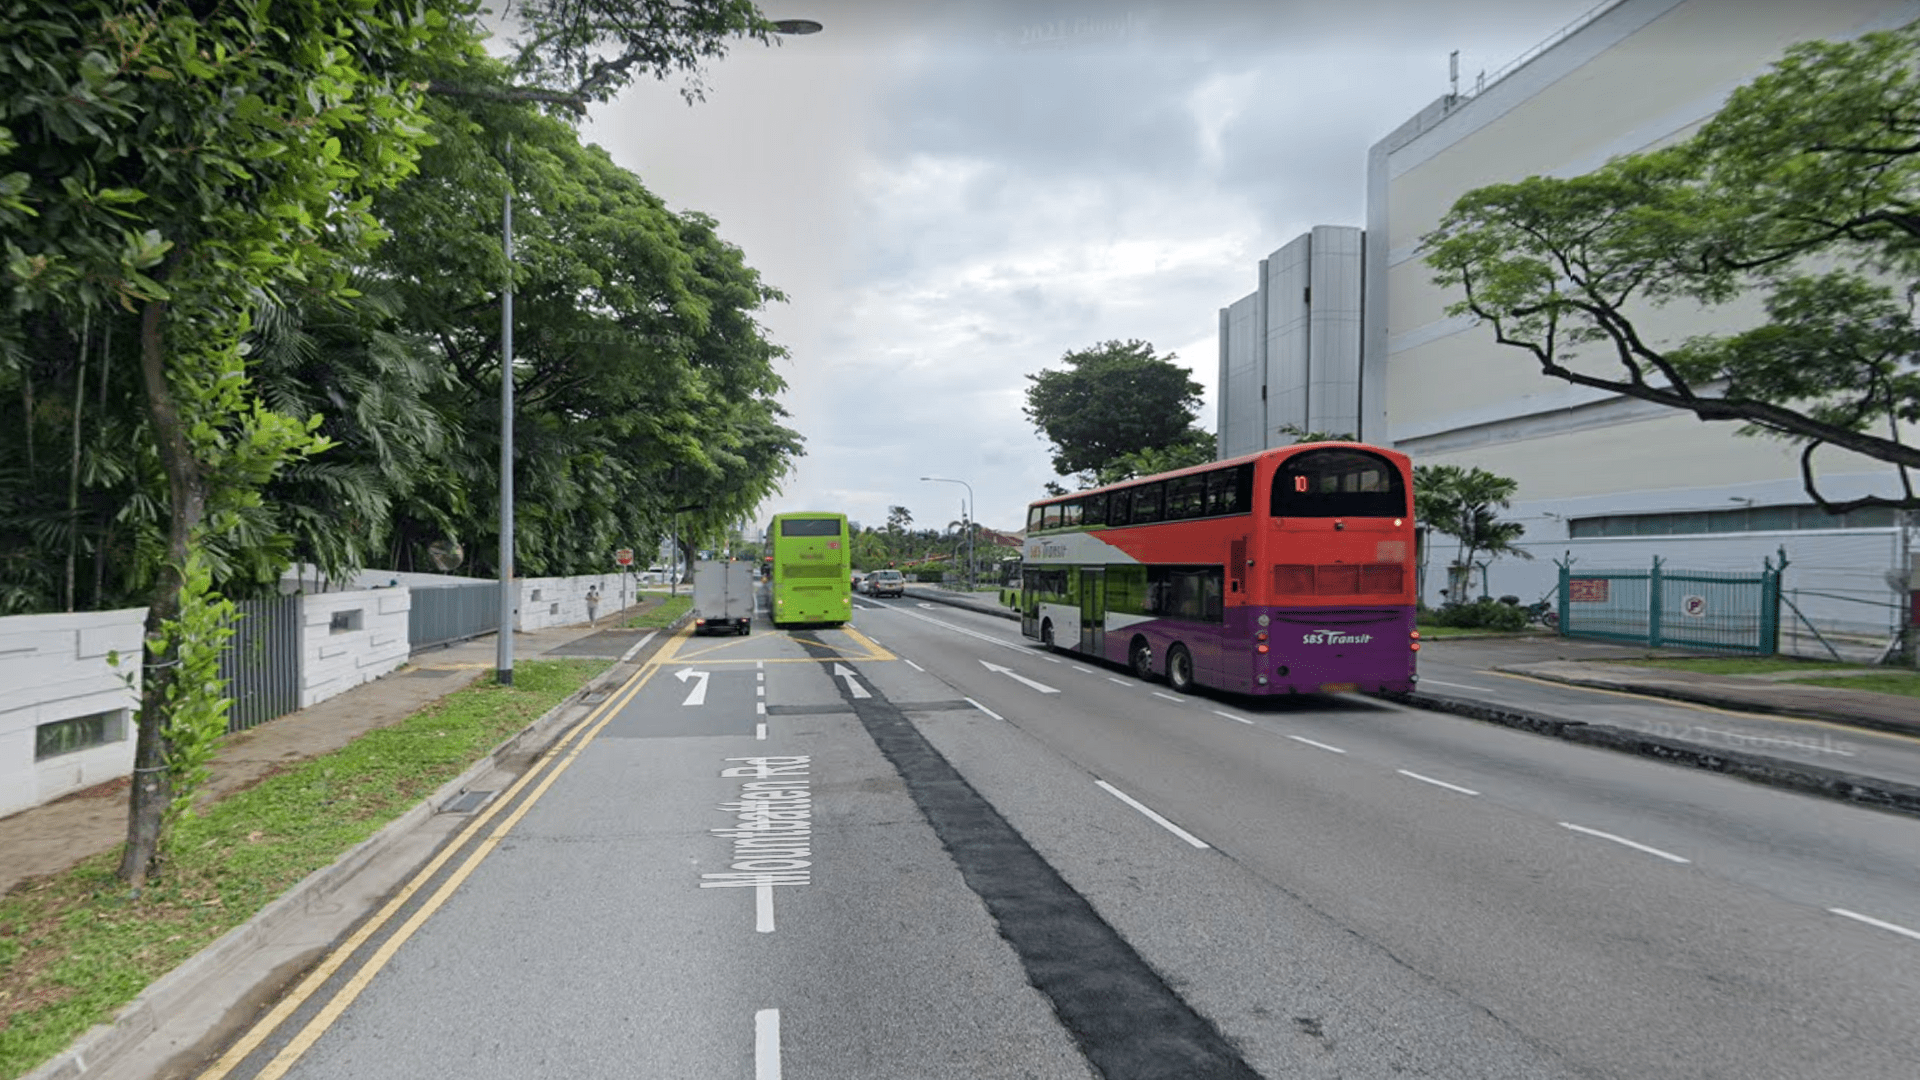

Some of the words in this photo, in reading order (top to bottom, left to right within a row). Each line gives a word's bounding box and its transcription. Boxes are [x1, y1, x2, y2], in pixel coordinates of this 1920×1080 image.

[1294, 475, 1308, 492] 10
[1303, 634, 1324, 644] SBS
[1313, 629, 1373, 645] Transit
[721, 755, 811, 777] Rd
[700, 780, 812, 888] Mountbatten
